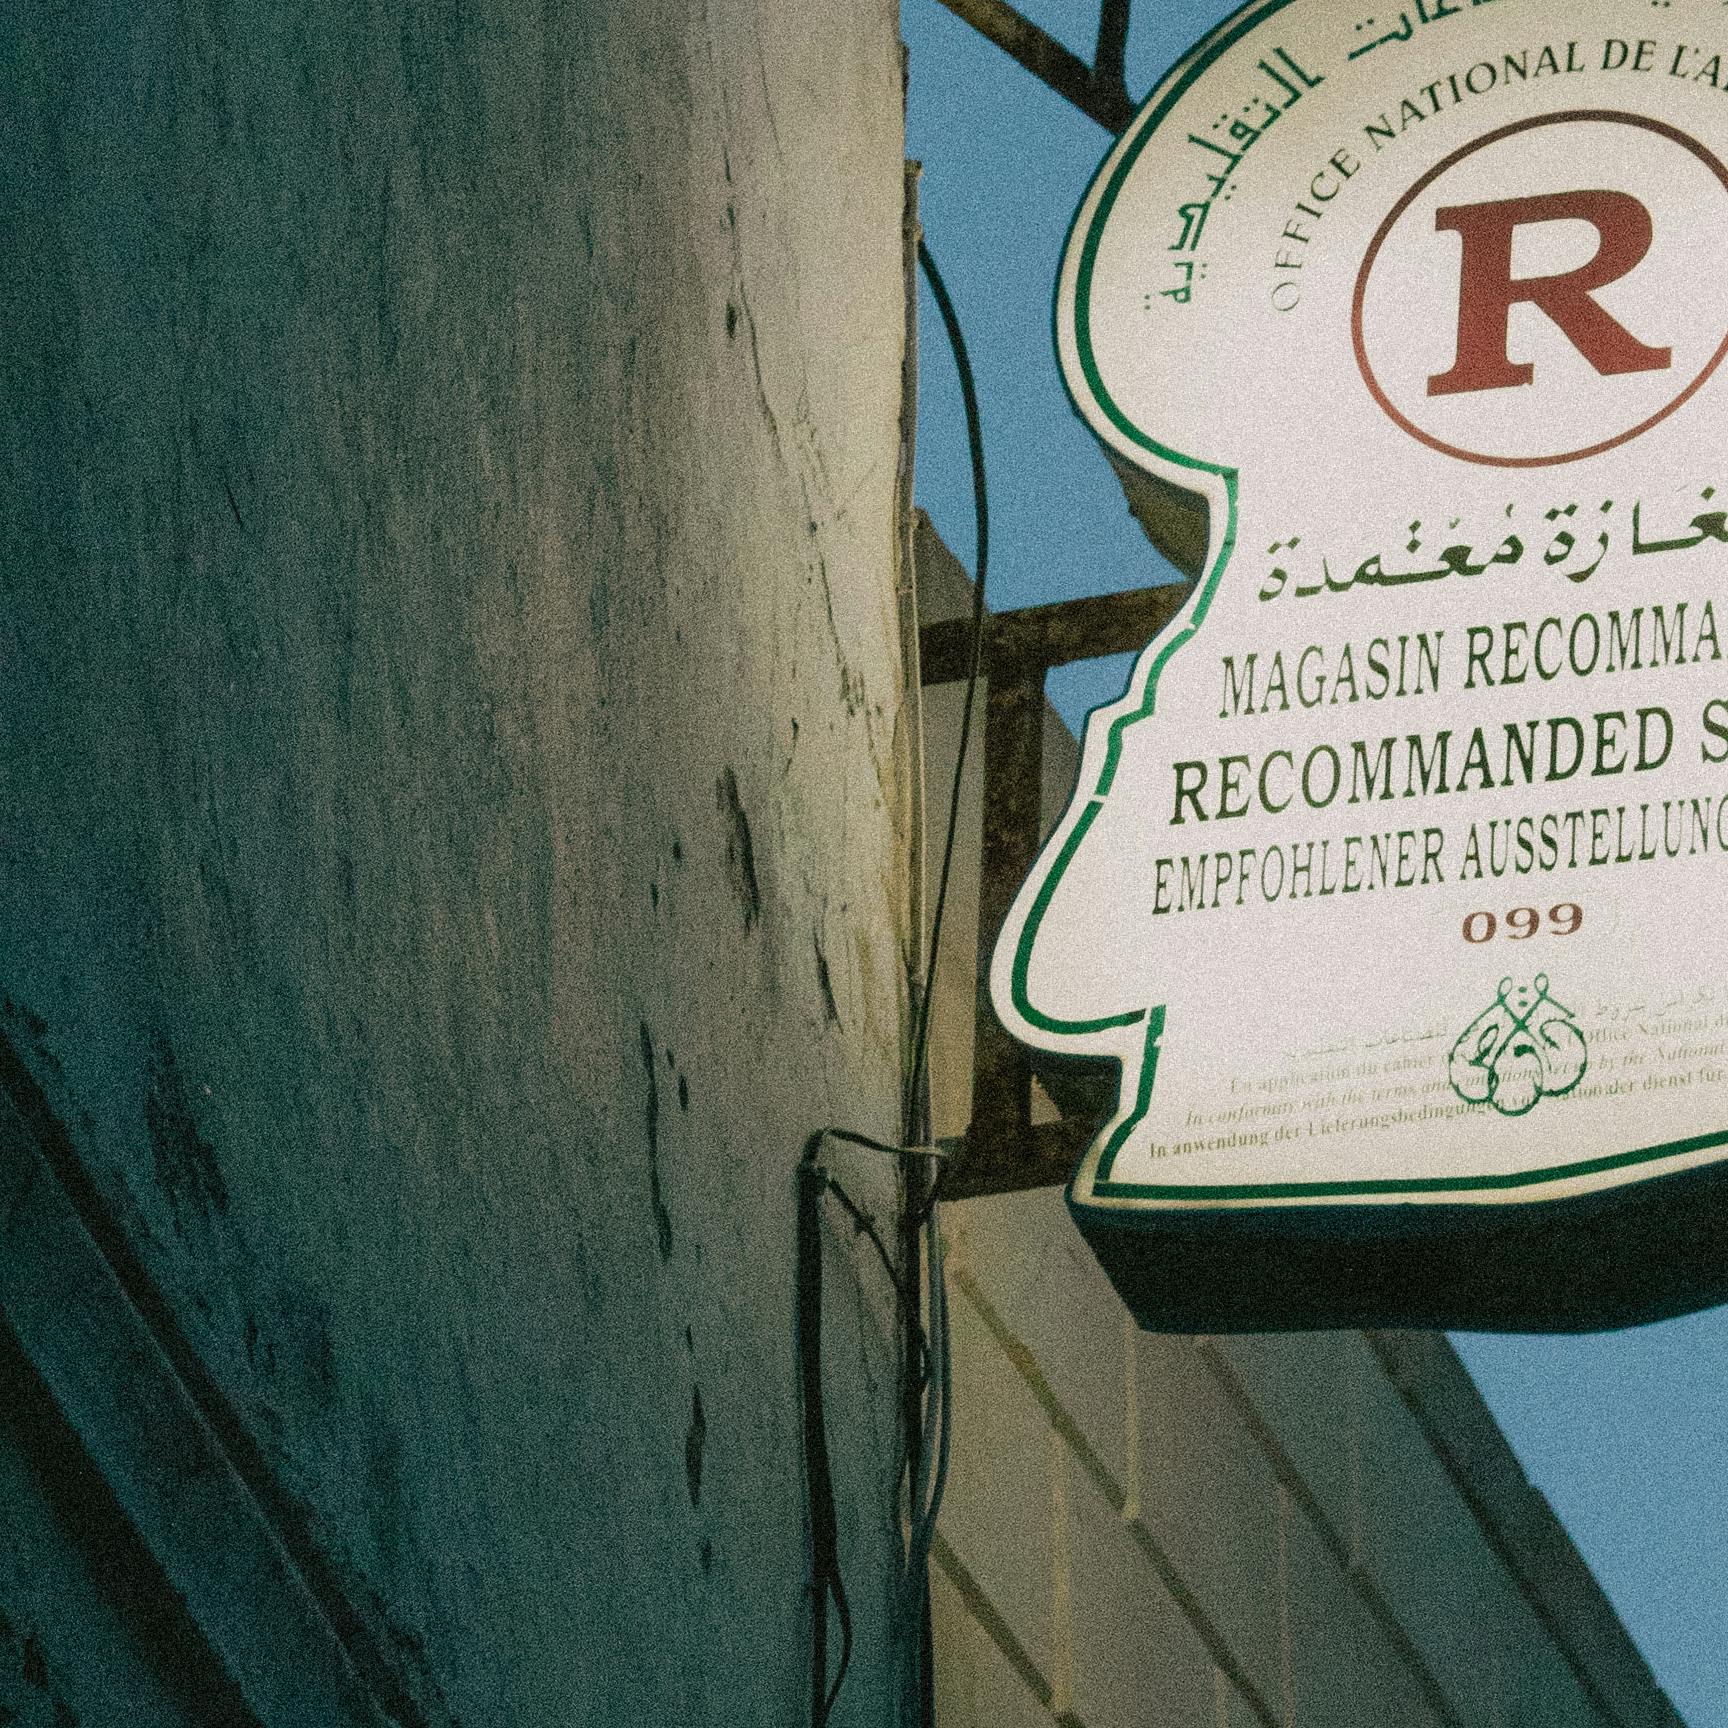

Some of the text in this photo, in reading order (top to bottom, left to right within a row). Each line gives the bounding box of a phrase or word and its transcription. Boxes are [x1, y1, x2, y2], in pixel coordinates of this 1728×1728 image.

[1143, 45, 1327, 312] التقليدية
[1270, 146, 1362, 313] OFFICE
[1363, 39, 1586, 153] NATIONAL
[1600, 37, 1657, 72] DE
[1425, 187, 1673, 398] R
[1218, 629, 1446, 720] MAGASIN
[1168, 705, 1676, 827] RECOMMANDED
[1151, 825, 1447, 917] EMPFOHLENER
[1460, 902, 1585, 945] 099
